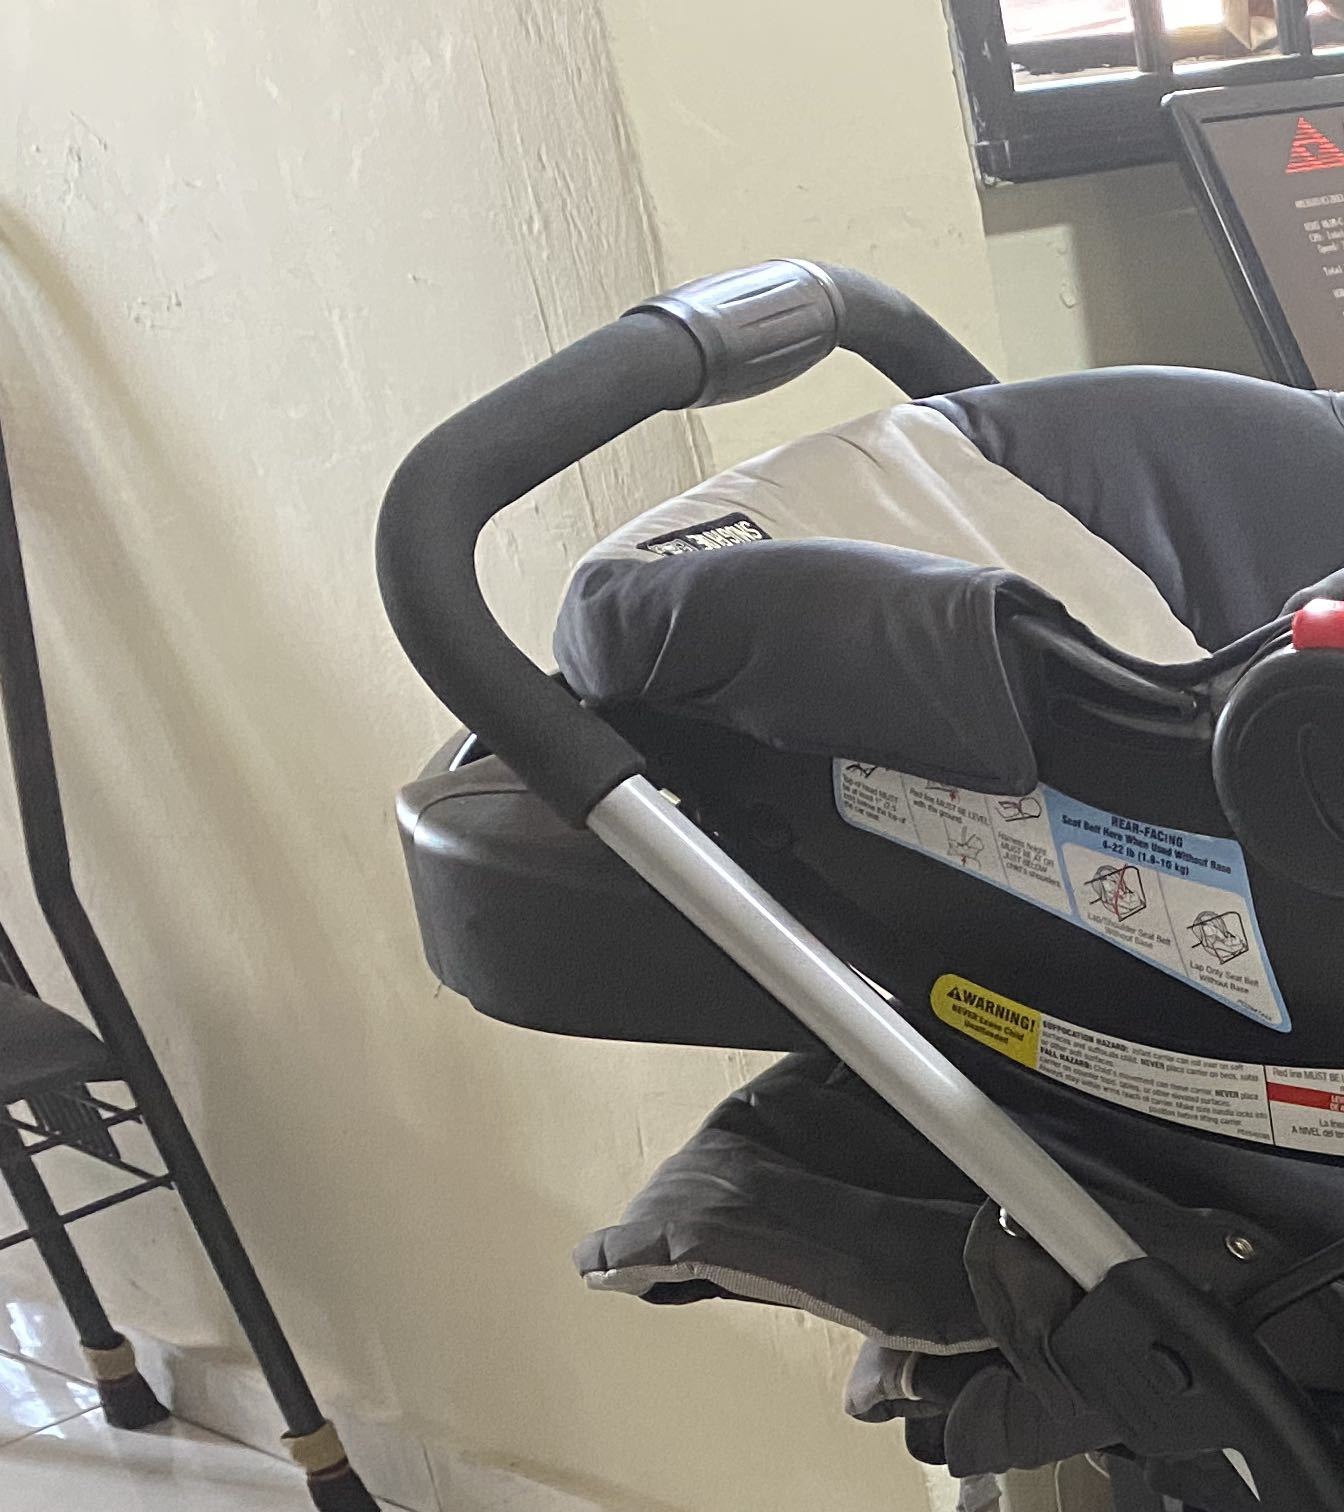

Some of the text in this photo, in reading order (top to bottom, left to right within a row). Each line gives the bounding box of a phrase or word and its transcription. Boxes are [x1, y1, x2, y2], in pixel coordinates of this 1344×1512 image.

[1109, 815, 1184, 848] REAR-FACING
[1081, 821, 1101, 834] Belt
[1101, 827, 1123, 841] Here
[1124, 834, 1149, 849] When
[1149, 842, 1173, 856] Used
[1174, 849, 1209, 867] Without
[1211, 860, 1233, 874] Base
[1125, 846, 1135, 857] lb
[1188, 959, 1205, 971] Lap
[1204, 965, 1223, 978] Only
[1224, 970, 1242, 982] Seat
[958, 989, 1038, 1032] WARNING!
[1139, 1058, 1165, 1070] NEVER
[1303, 1070, 1328, 1081] MUST
[1214, 1087, 1239, 1100] NEVER
[1298, 1126, 1321, 1136] NIVEL
